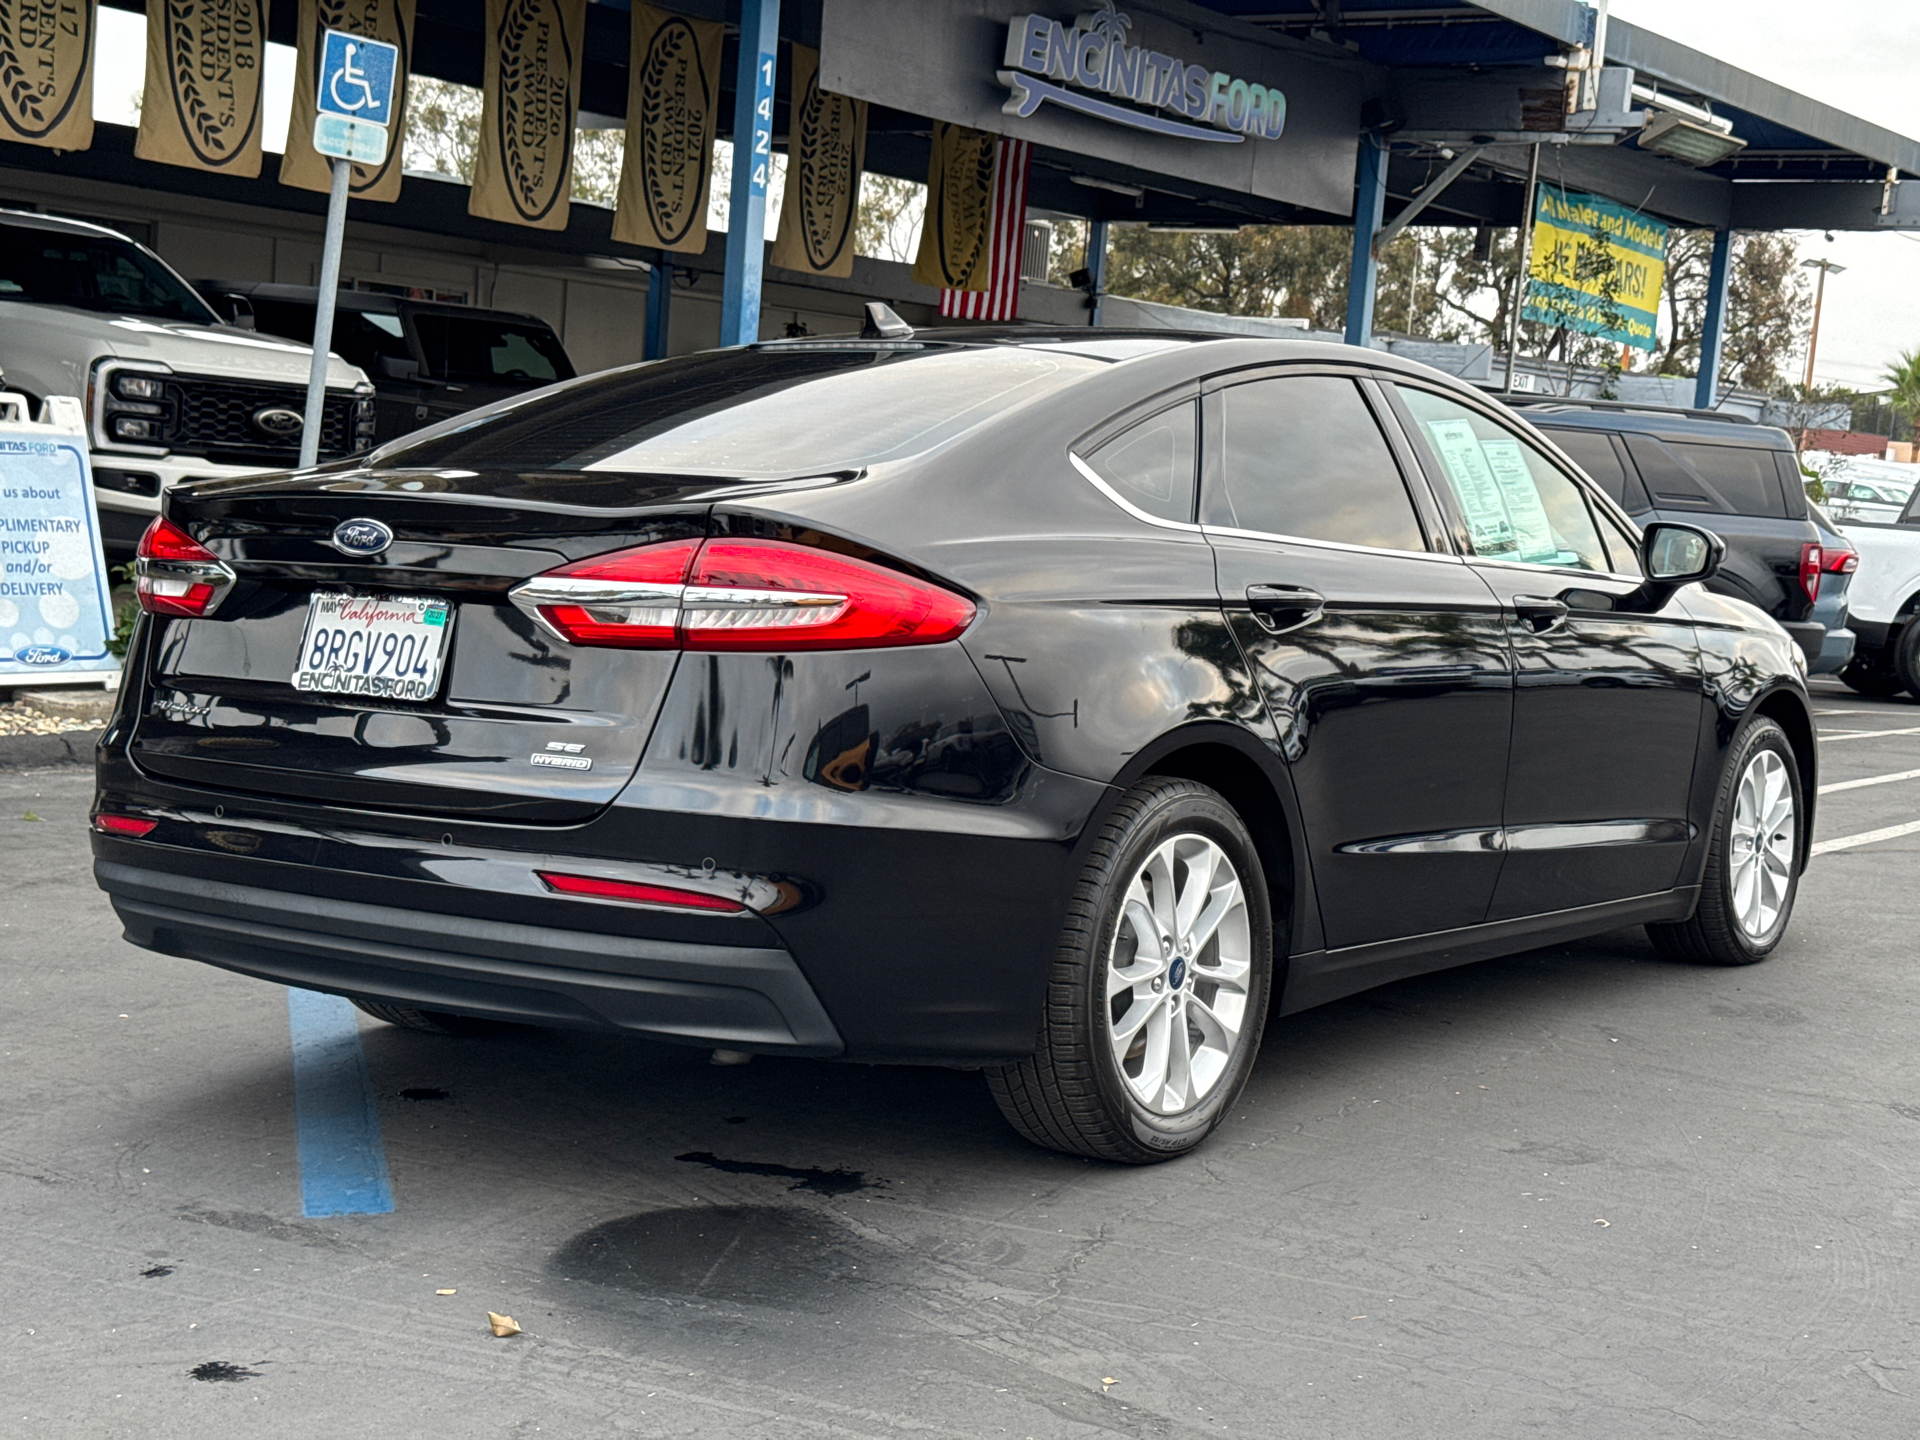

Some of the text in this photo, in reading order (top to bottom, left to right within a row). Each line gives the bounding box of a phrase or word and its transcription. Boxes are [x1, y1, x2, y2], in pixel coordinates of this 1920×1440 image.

[234, 1, 255, 70] 2018
[1017, 12, 1288, 141] ENCINITAS FORD
[521, 55, 536, 148] AWARD
[532, 20, 550, 189] PRESIDENT'S
[550, 76, 566, 138] 2020
[660, 88, 675, 177] AWARD
[671, 57, 688, 214] PRESIDENT'S
[687, 109, 703, 162] 2021
[816, 125, 831, 207] AWARD
[821, 95, 842, 241] PRESIDENT'S
[837, 144, 851, 196] 2022
[1599, 213, 1624, 237] and
[1623, 218, 1664, 251] Models
[1627, 318, 1652, 339] Quote
[28, 442, 57, 454] FORD
[3, 485, 62, 500] us about
[1, 540, 51, 554] PICKUP
[343, 525, 378, 547] Ford
[5, 558, 53, 576] and/or
[0, 582, 63, 596] DELIVERY
[320, 601, 339, 614] MAY
[338, 599, 425, 629] California
[25, 647, 62, 664] Ford
[309, 627, 430, 679] 8RGV904
[298, 671, 428, 699] ENCINITAS FORD
[533, 755, 588, 769] HYBRID
[545, 741, 587, 754] SE
